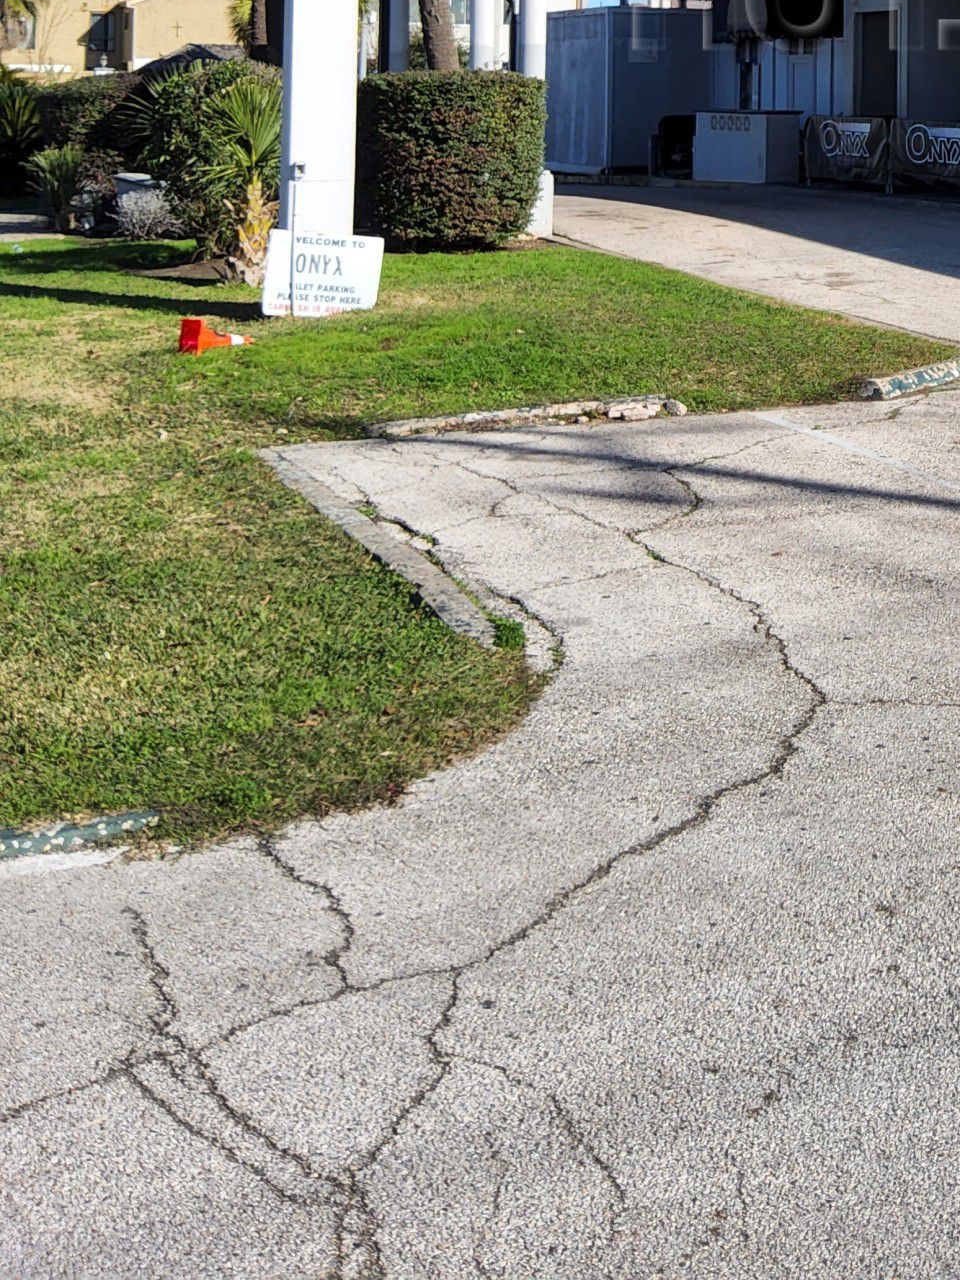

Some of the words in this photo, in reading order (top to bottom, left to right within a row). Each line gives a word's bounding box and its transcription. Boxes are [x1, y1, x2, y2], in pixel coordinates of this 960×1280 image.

[352, 240, 366, 249] TO
[295, 252, 343, 276] ONYX
[317, 285, 355, 294] PARKING
[313, 294, 336, 303] STOP
[339, 296, 361, 305] HERE
